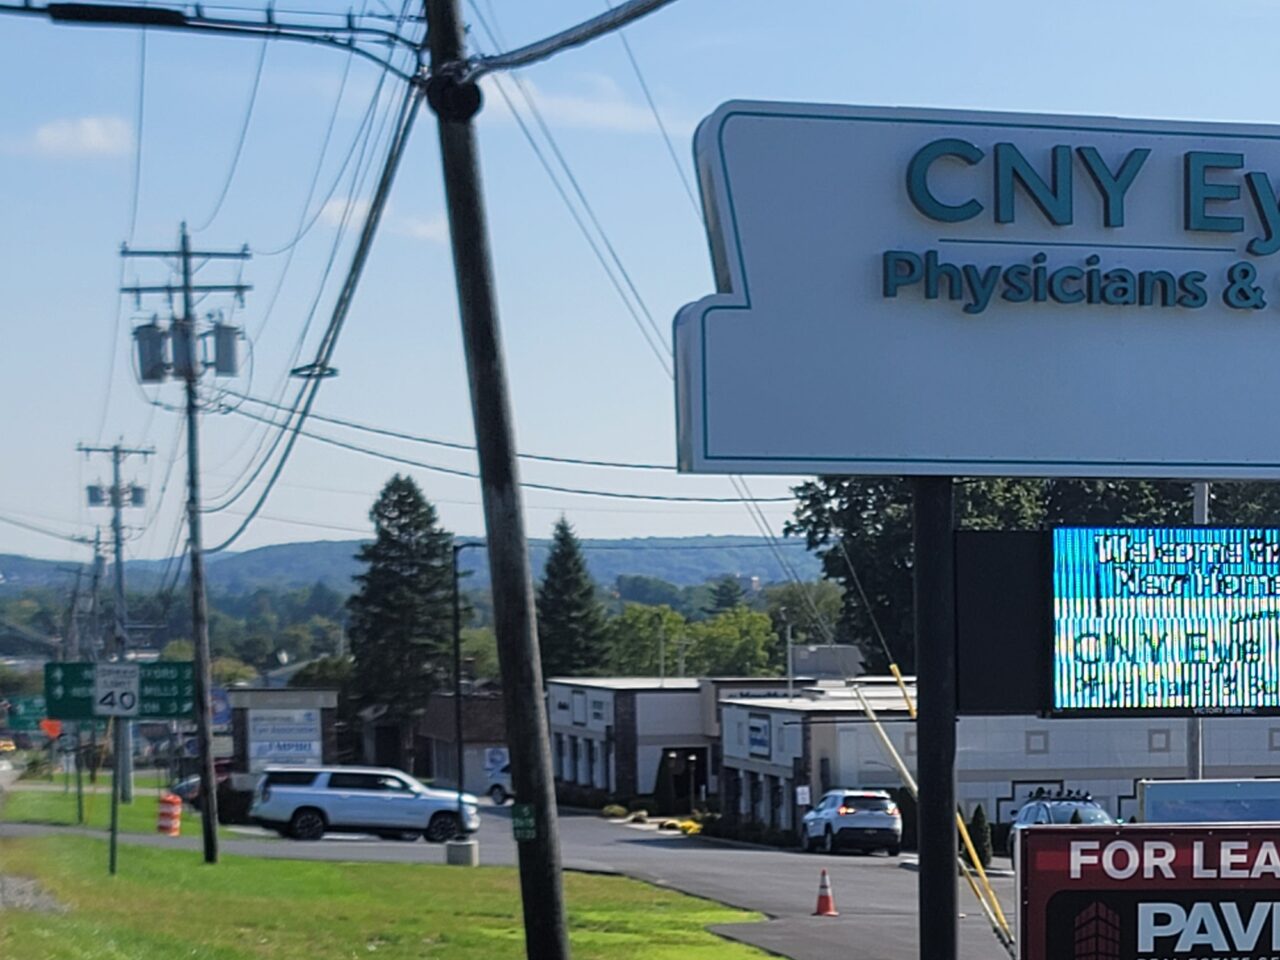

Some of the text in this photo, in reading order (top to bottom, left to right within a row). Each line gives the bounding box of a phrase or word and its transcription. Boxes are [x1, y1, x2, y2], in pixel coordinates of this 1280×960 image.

[906, 138, 1152, 227] CNY
[882, 250, 1207, 314] Physicians
[1223, 261, 1266, 308] &
[1094, 534, 1242, 564] Welcome
[1114, 566, 1188, 596] New
[1074, 632, 1169, 664] CNY
[98, 690, 137, 711] 40
[1069, 840, 1177, 880] FOR
